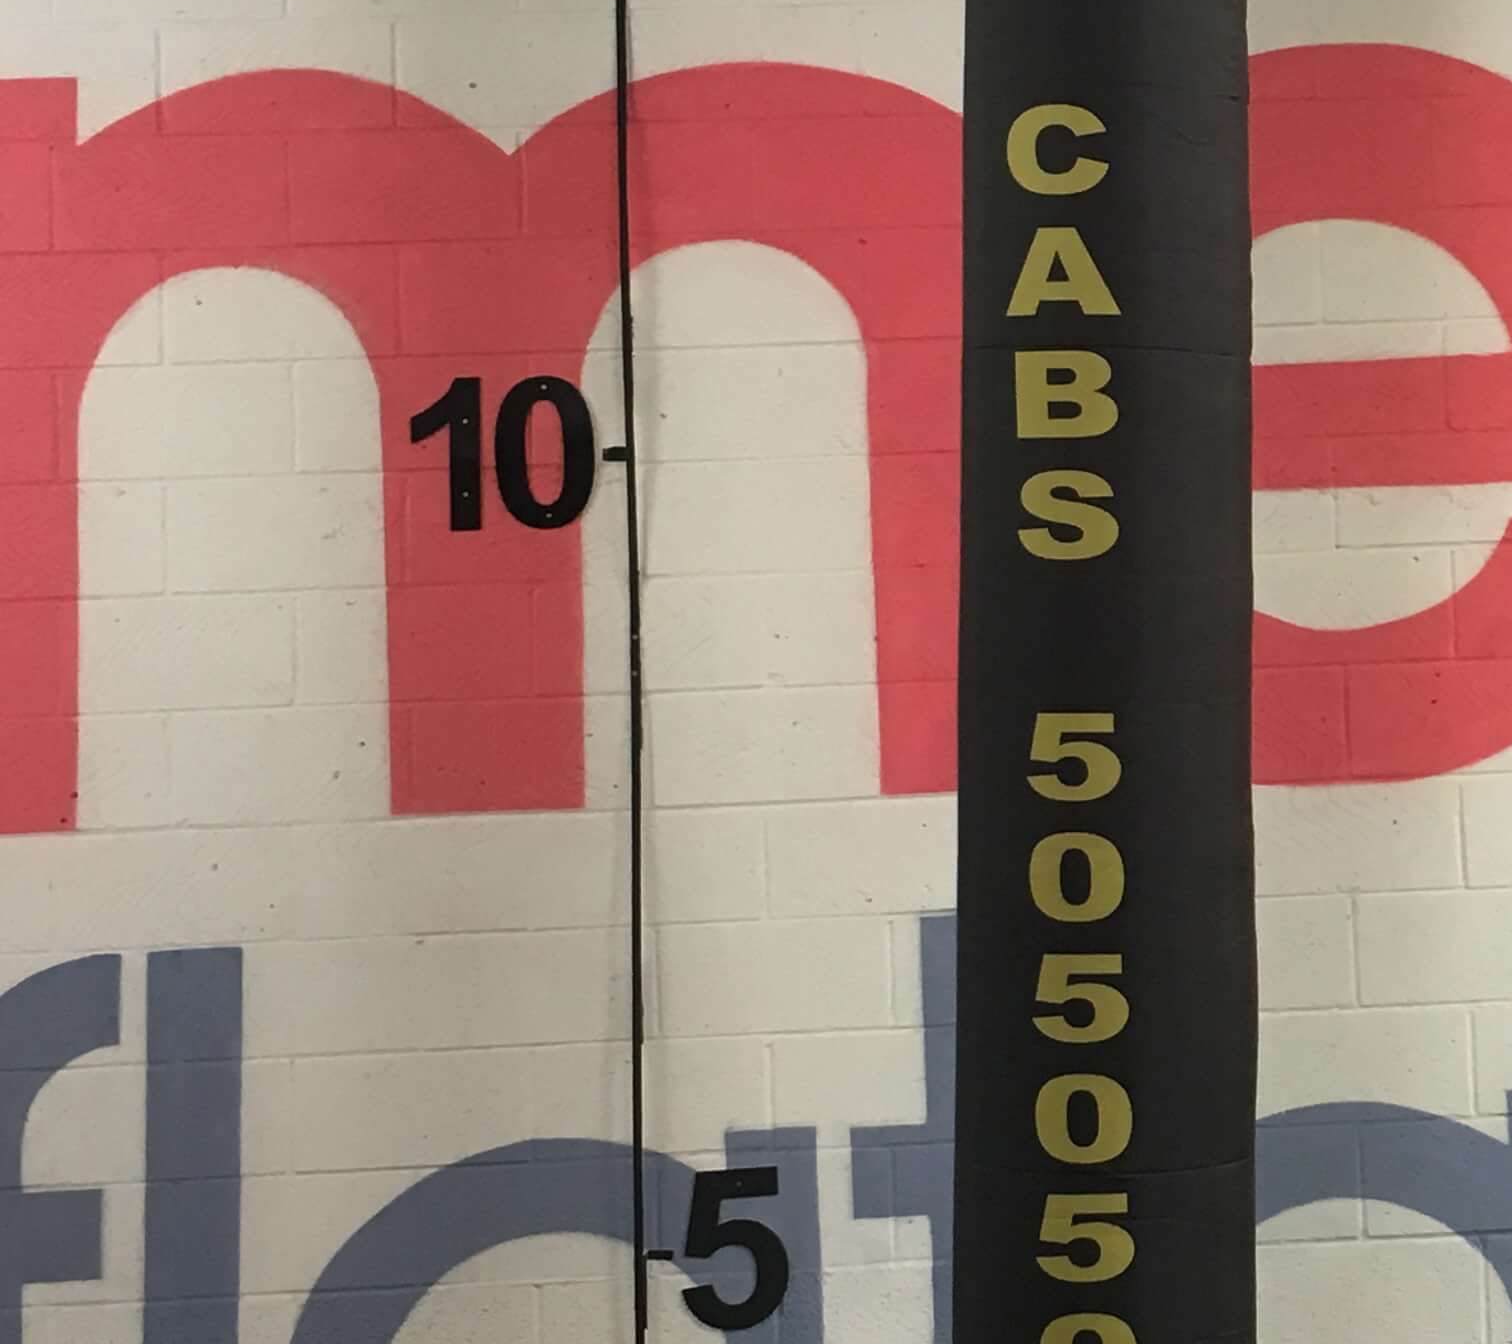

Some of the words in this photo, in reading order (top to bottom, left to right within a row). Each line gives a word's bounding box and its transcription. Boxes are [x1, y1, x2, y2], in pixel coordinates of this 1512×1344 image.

[1004, 104, 1121, 561] CABS
[410, 375, 596, 531] 10
[681, 1165, 790, 1331] 5
